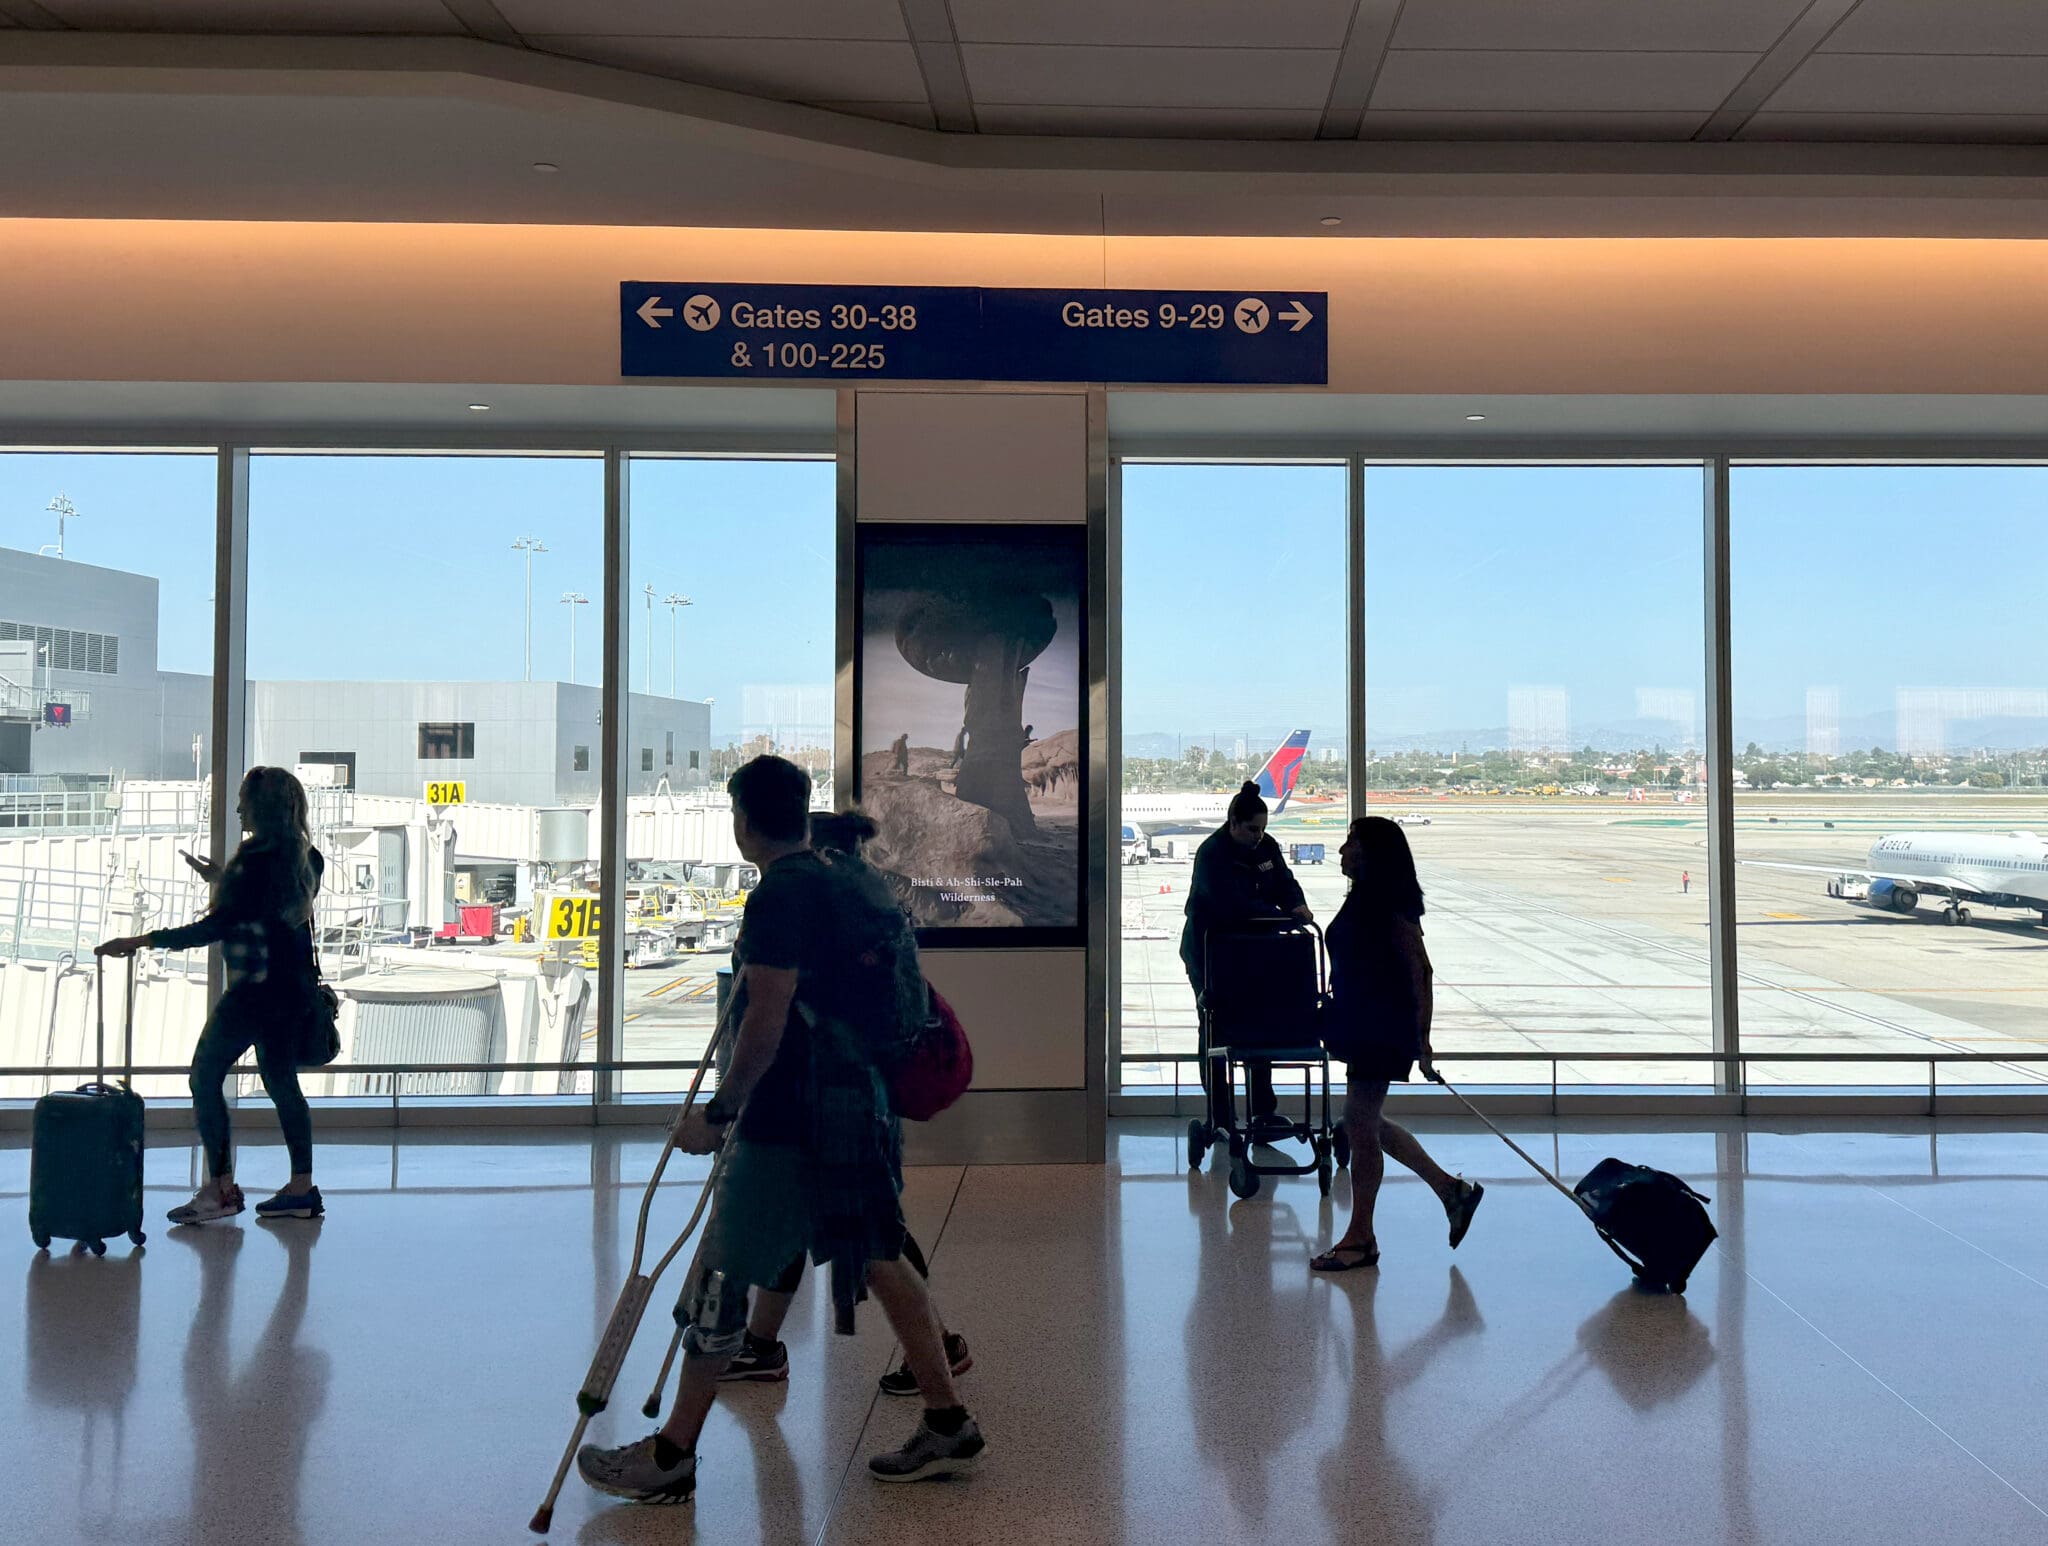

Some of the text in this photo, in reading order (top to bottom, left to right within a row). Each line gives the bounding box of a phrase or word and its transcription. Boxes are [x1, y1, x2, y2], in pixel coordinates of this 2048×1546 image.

[731, 301, 917, 331] Gates 30-38
[1062, 301, 1225, 330] Gates 9-29
[731, 341, 885, 370] & 100-225
[430, 783, 461, 803] 31A
[1886, 840, 1912, 850] DELTA
[911, 877, 1023, 887] Bisti & Ah-Shi-Sle-Pah
[940, 892, 996, 902] Wilderness
